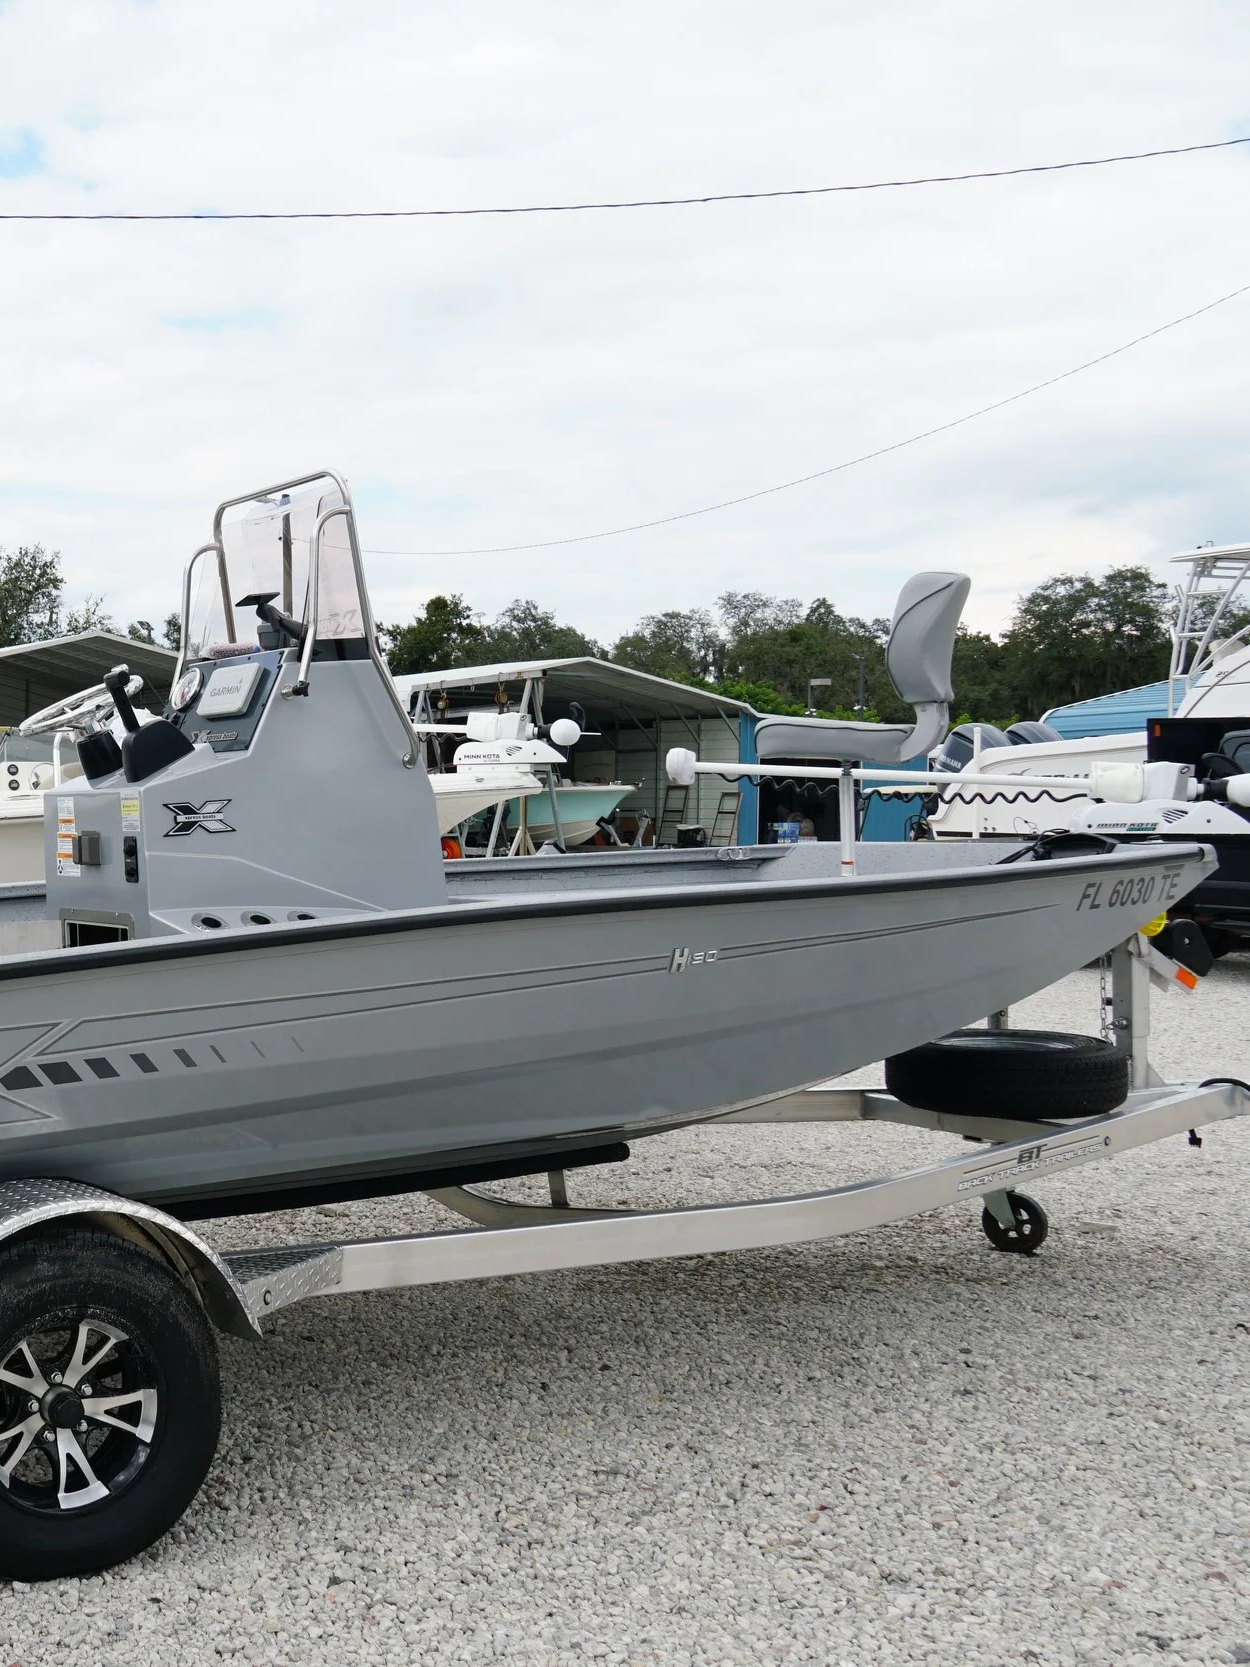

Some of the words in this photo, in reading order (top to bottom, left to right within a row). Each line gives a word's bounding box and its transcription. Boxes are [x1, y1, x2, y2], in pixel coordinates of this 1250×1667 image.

[210, 685, 241, 697] GARMIN
[1076, 882, 1102, 911] FL
[1108, 876, 1155, 908] 6030
[1157, 872, 1181, 901] TE
[957, 1173, 994, 1191] BACK
[997, 1159, 1043, 1179] TRACK
[1044, 1143, 1104, 1166] TRAILERS
[1017, 1144, 1048, 1164] BT
